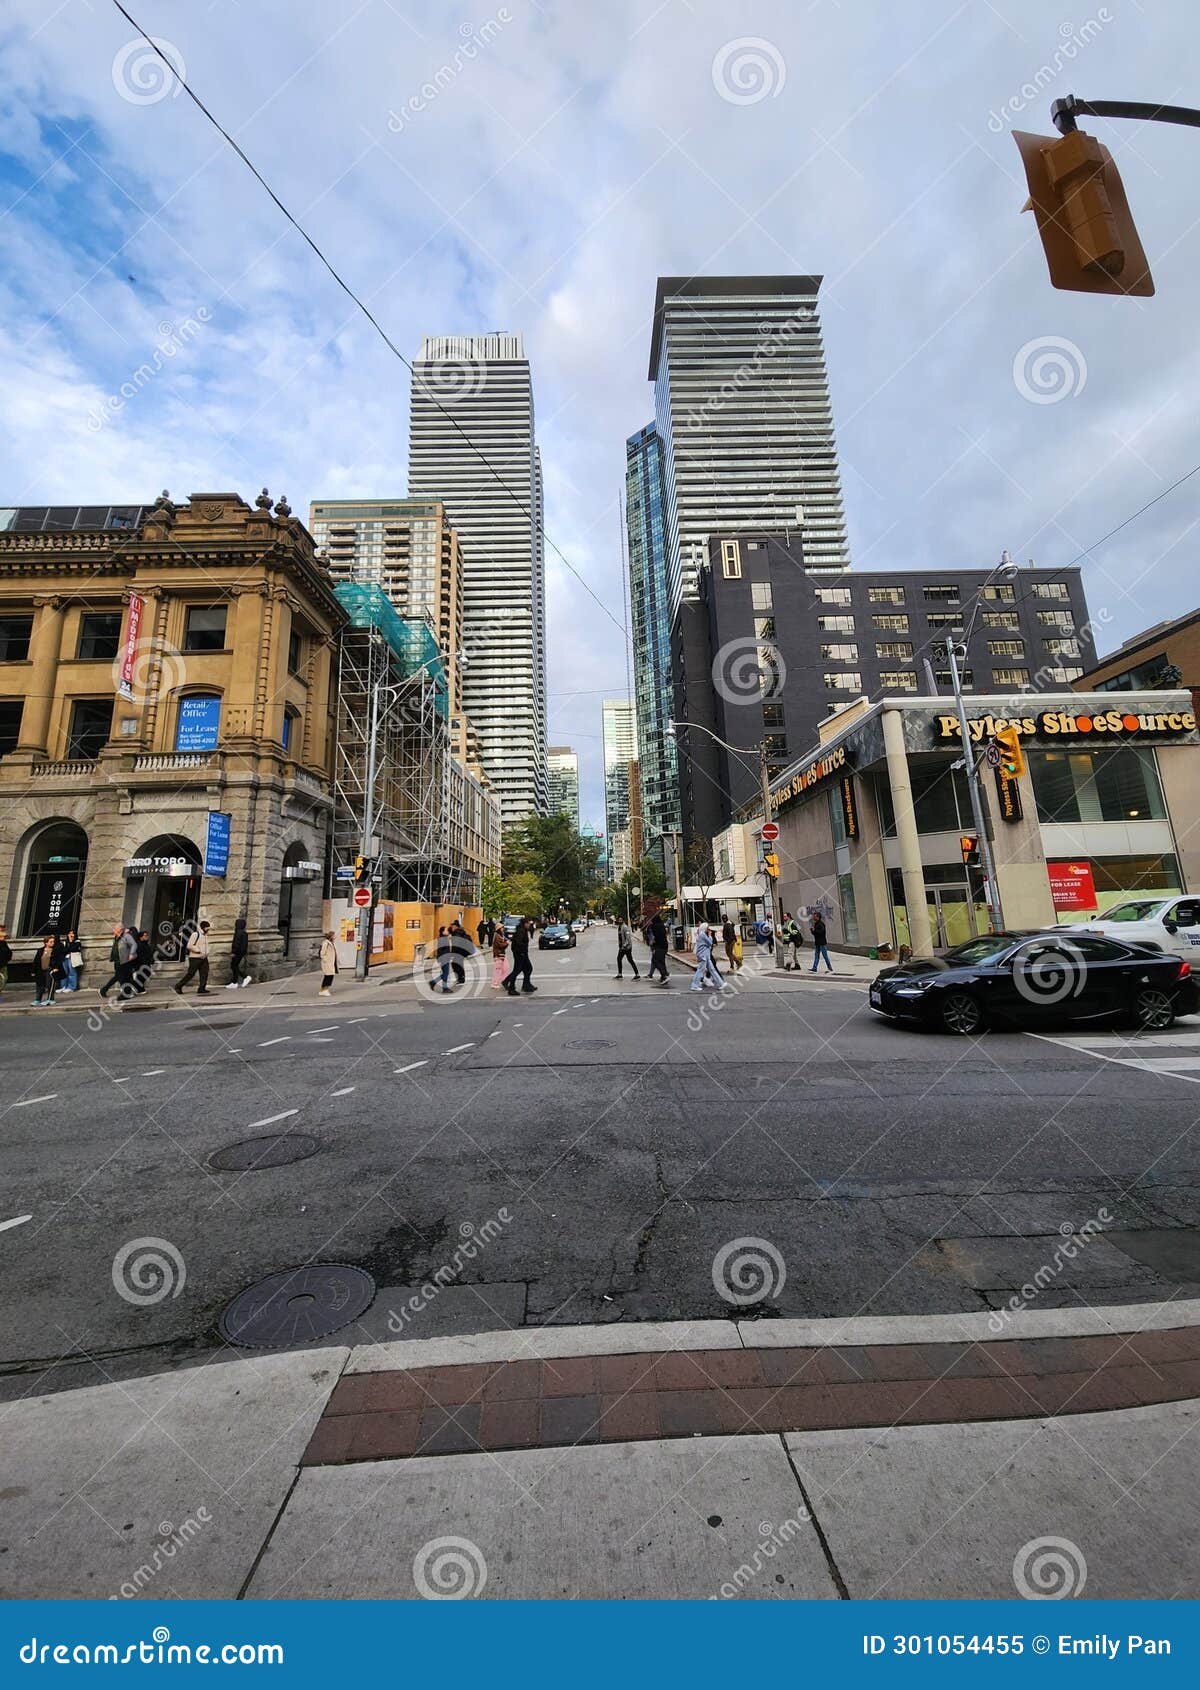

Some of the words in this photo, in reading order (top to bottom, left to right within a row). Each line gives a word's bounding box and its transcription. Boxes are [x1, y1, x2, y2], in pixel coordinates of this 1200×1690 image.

[1043, 711, 1196, 734] ShoeSource
[792, 747, 845, 796] ShoeSource
[1004, 791, 1014, 817] Payless
[154, 857, 186, 865] TORO
